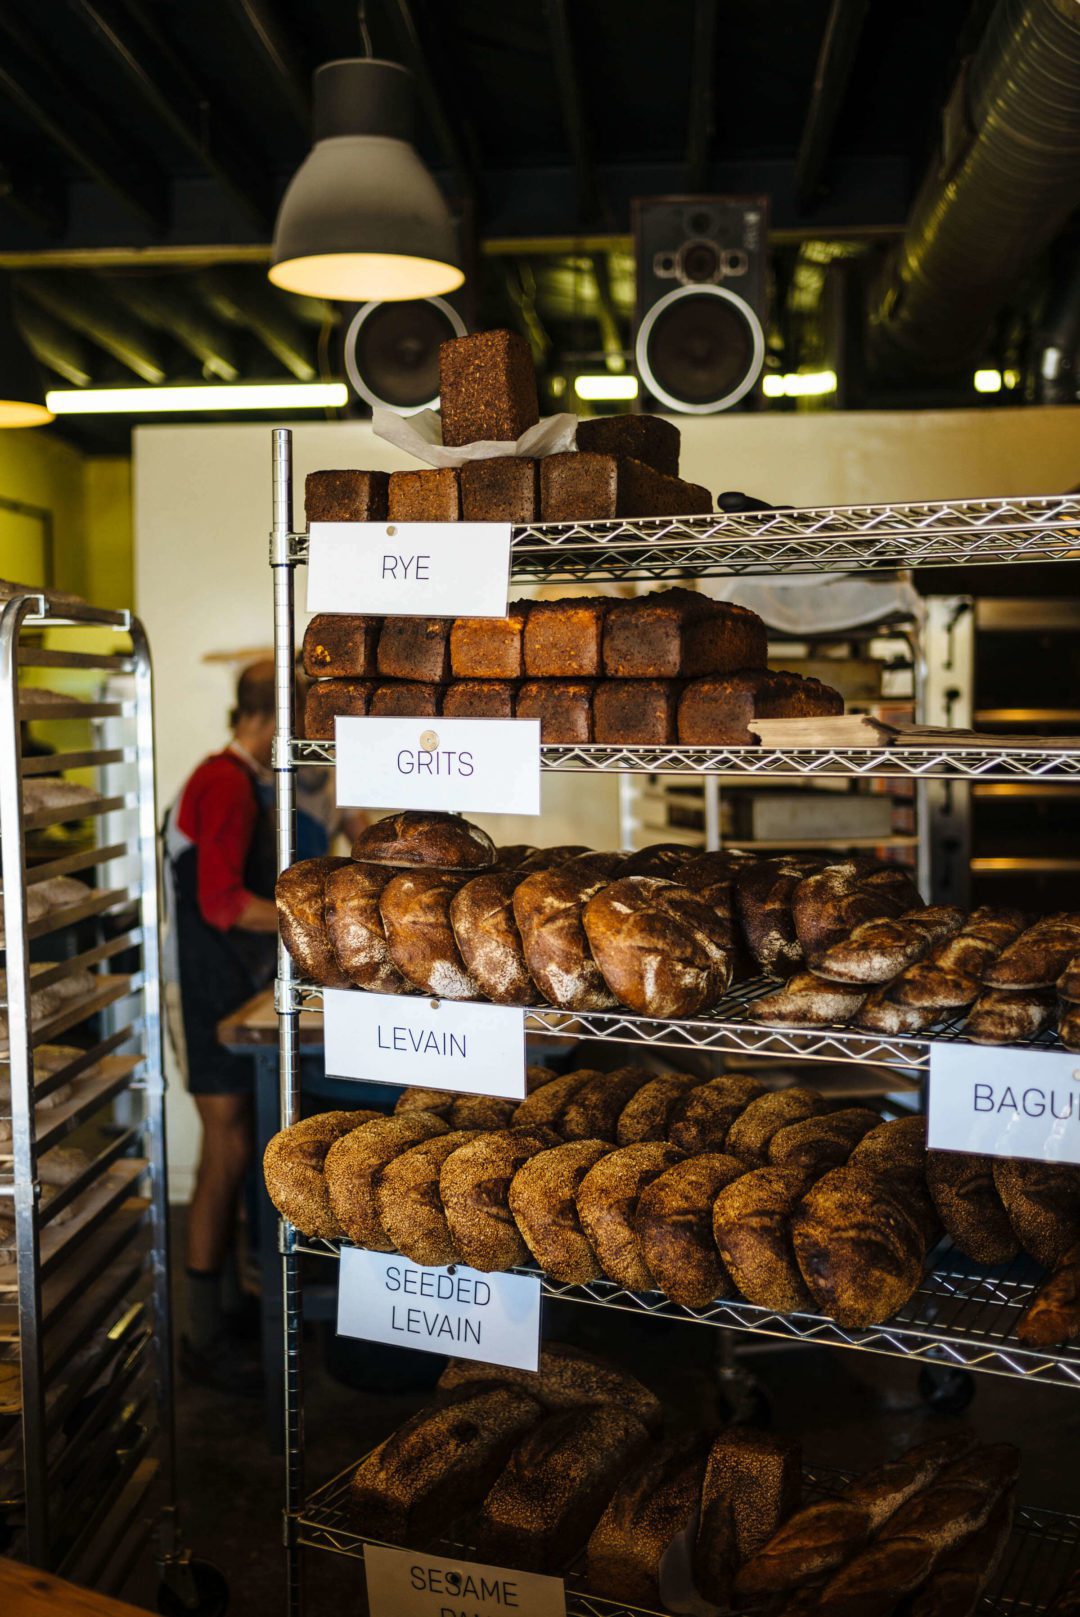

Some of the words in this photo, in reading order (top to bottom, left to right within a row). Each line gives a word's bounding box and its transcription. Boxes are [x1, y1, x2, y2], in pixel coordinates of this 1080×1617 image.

[381, 555, 431, 580] RYE
[396, 749, 474, 777] GRITS
[377, 1025, 467, 1058] LEVAIN
[974, 1083, 1080, 1120] BAGU
[385, 1266, 491, 1306] SEEDED
[391, 1305, 482, 1345] LEVAIN
[410, 1565, 520, 1607] SESAME
